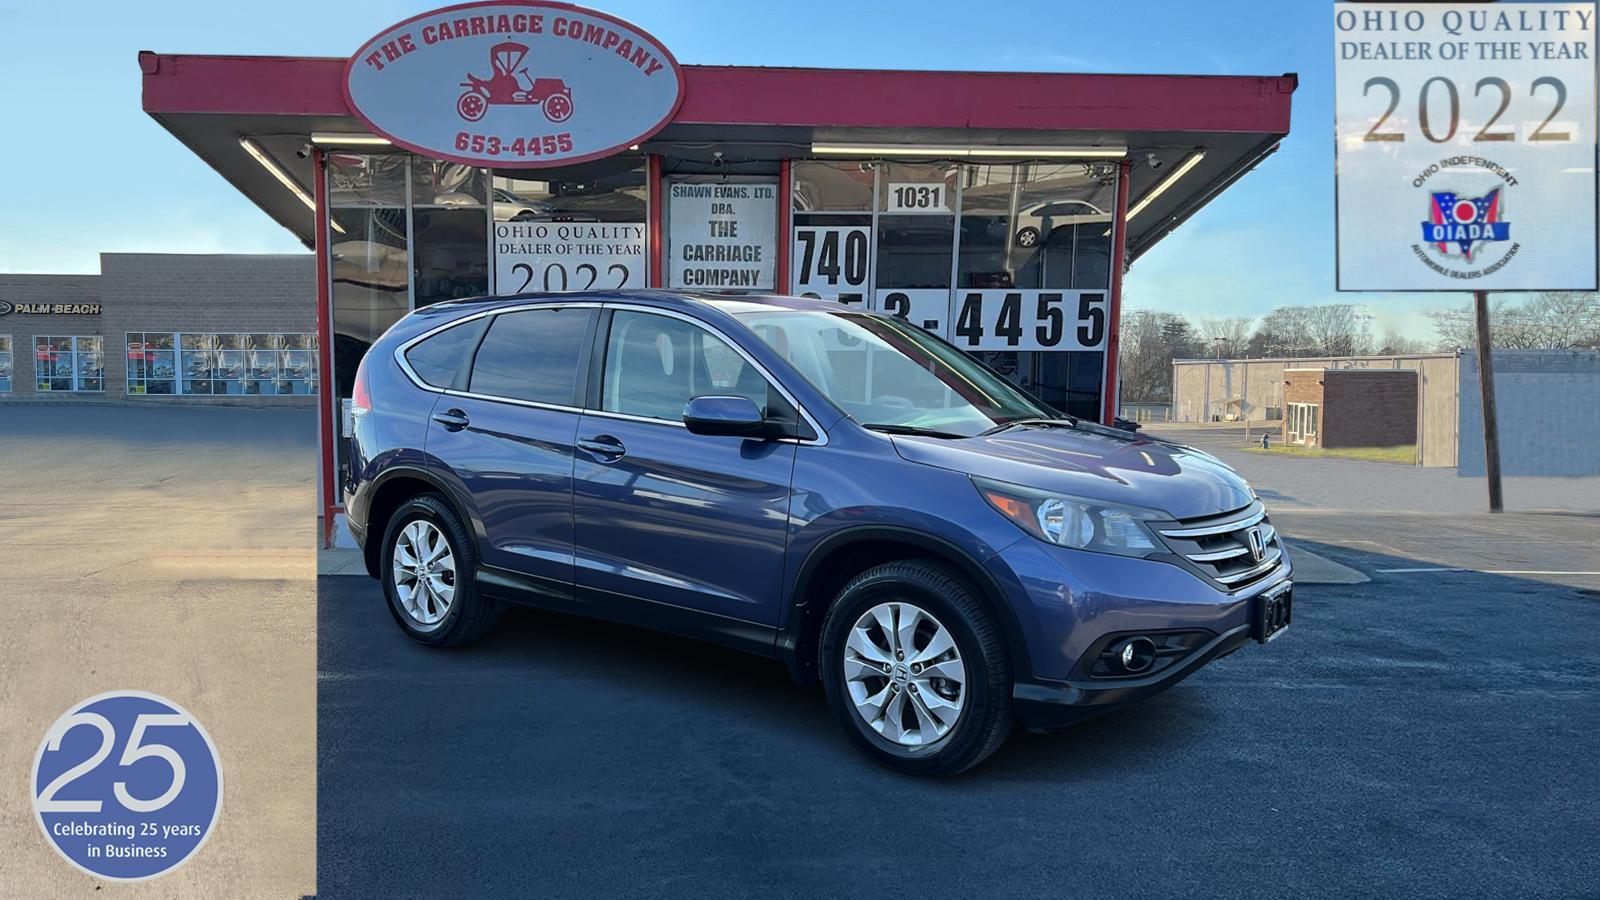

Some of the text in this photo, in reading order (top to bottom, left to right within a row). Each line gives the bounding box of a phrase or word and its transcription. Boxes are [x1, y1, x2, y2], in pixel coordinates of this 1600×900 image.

[1336, 10, 1593, 35] OHIO QUALITY
[365, 14, 664, 78] THE CARRIAGE COMPANY
[1340, 41, 1589, 60] DEALER OF THE YEAR
[1362, 76, 1571, 143] 2022
[455, 131, 573, 156] 653-4455
[1412, 156, 1519, 188] OHIO INDEPENDENT
[672, 186, 712, 199] SHAWN
[754, 186, 775, 199] LTD.
[894, 186, 941, 209] 1031
[711, 203, 736, 215] DBA.
[497, 226, 644, 241] OHIO QUALITY
[708, 220, 738, 238] THE
[1432, 225, 1495, 240] OIADA
[499, 244, 641, 255] DEALER OF THE YEAR
[683, 244, 762, 262] CARRIAGE
[797, 230, 868, 286] 740
[1411, 242, 1520, 279] AUTOMOBILE DEALERS ASSOCIATION
[511, 263, 629, 294] 2022
[683, 268, 760, 286] COMPANY
[15, 304, 100, 314] PALM BEACH
